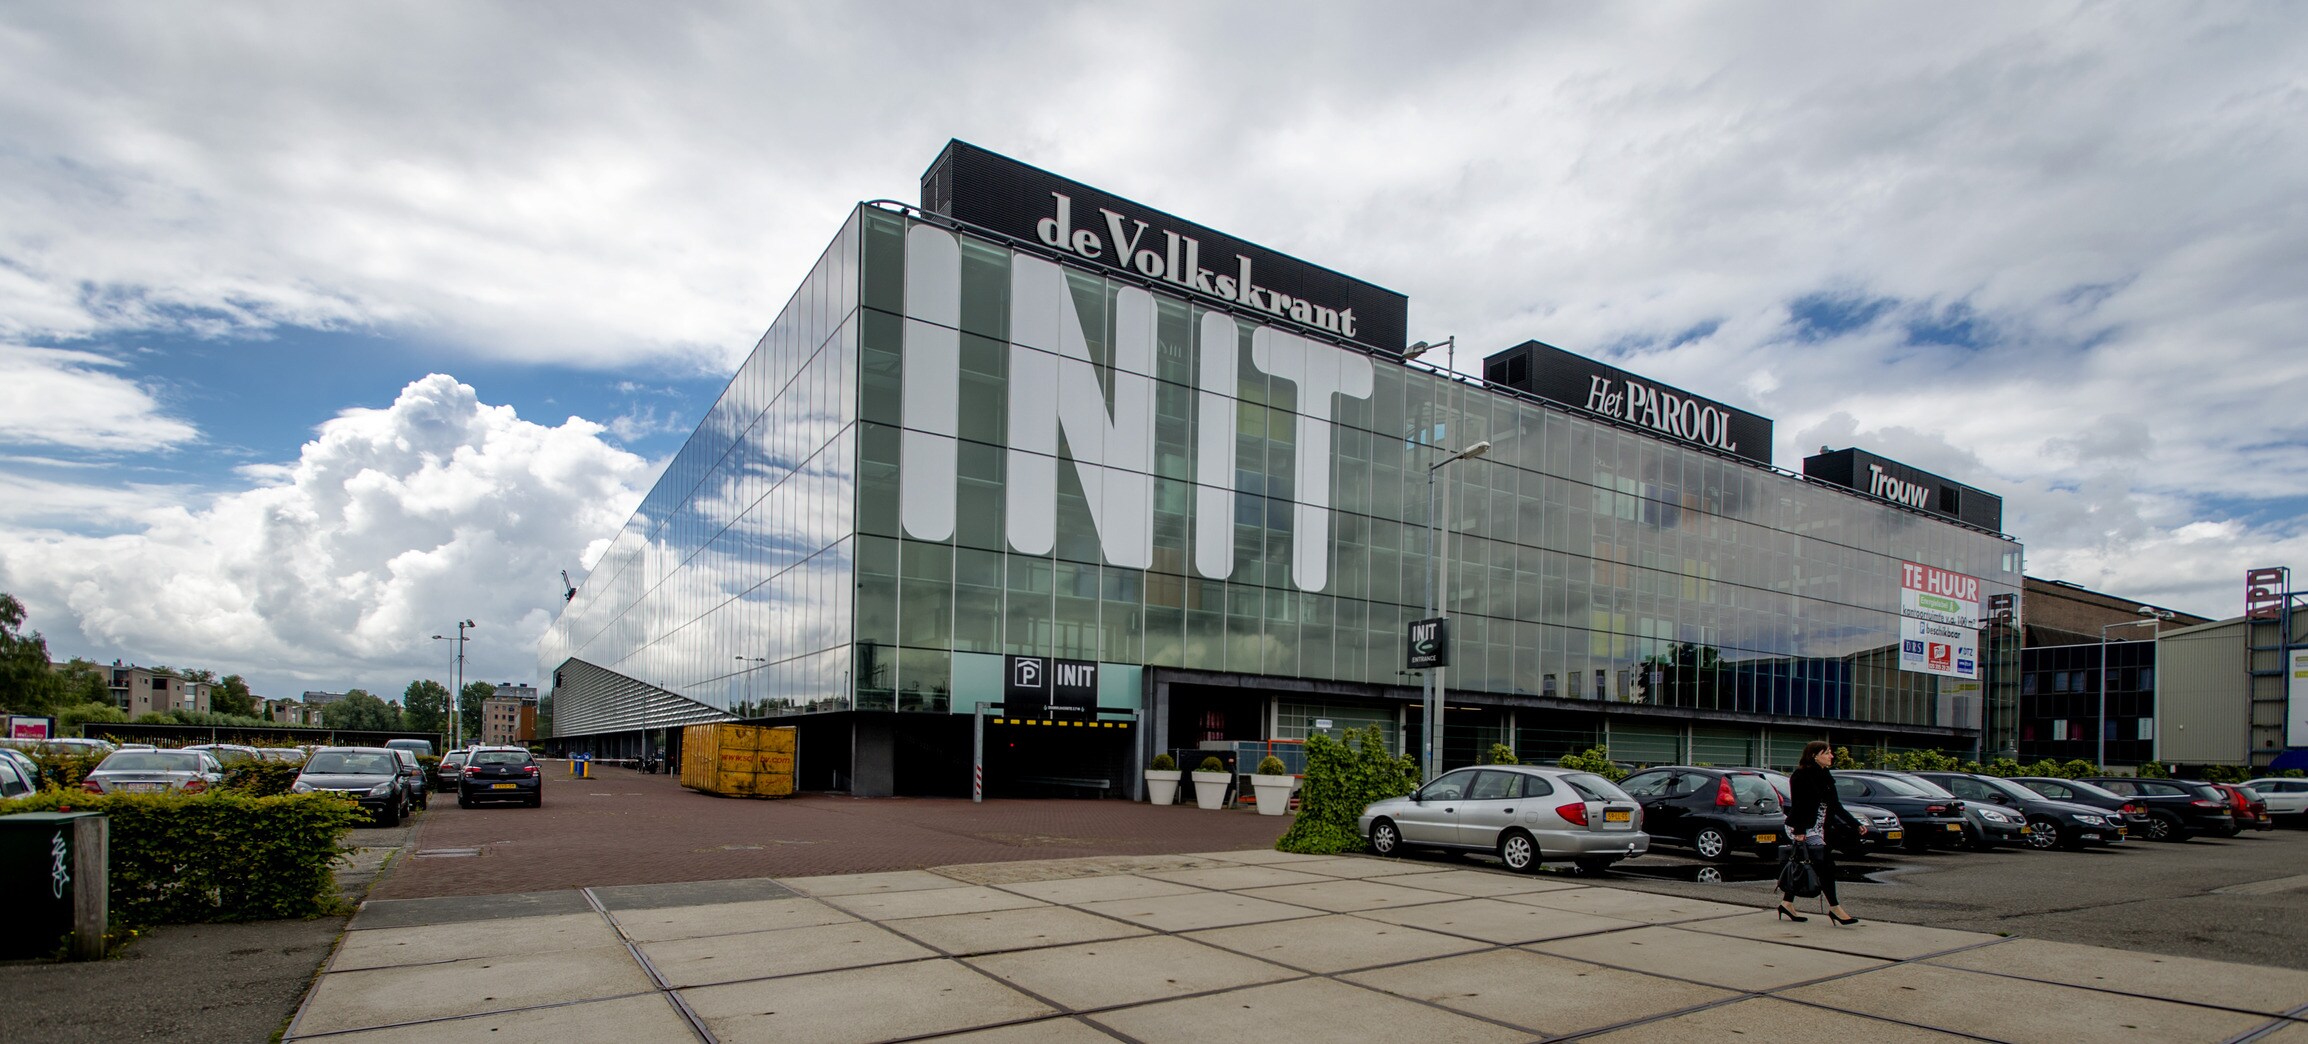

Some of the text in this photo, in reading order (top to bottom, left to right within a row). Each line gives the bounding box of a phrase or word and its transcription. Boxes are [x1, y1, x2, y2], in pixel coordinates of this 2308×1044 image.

[1100, 208, 1356, 337] Volkskrant
[902, 224, 1374, 593] INIT
[1584, 374, 1736, 452] Het PAROOL
[1869, 463, 1930, 509] Trouw
[1903, 563, 1977, 601] TE HUUR
[1412, 623, 1437, 642] INIT
[1905, 641, 1922, 654] DRS
[1057, 663, 1095, 688] INIT
[1412, 655, 1437, 663] ENTRANCE
